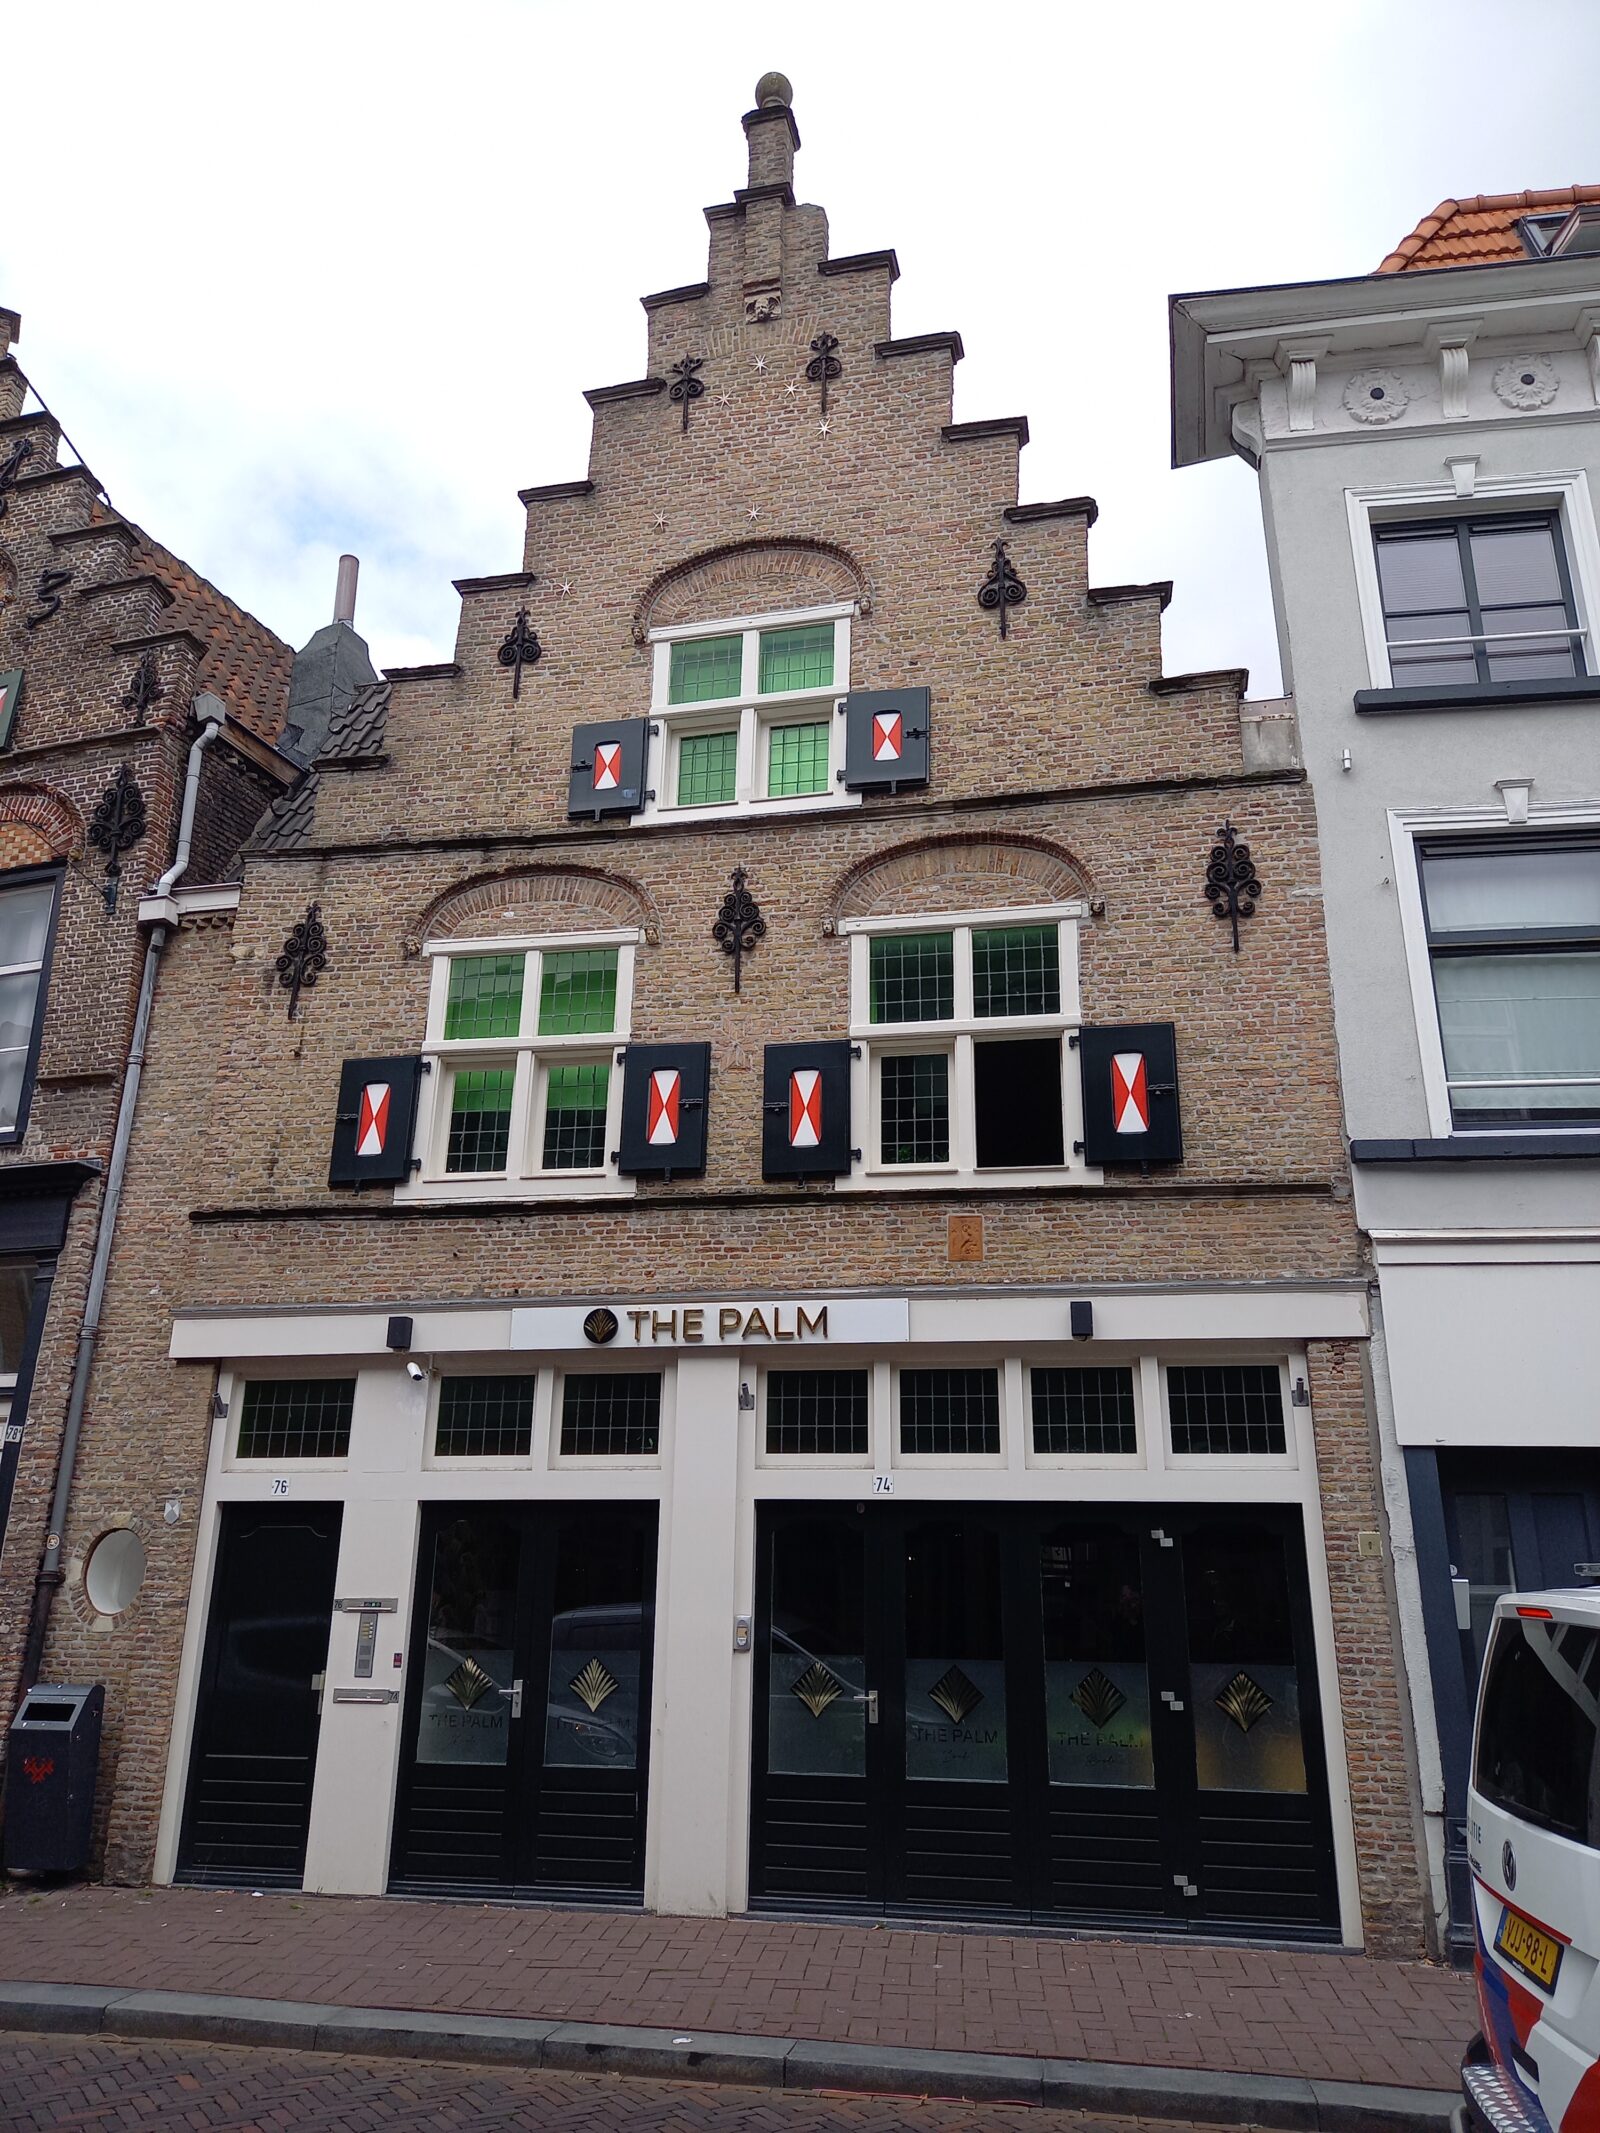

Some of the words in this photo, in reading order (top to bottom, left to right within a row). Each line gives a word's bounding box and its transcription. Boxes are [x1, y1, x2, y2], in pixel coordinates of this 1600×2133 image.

[626, 1308, 705, 1342] THE
[719, 1305, 829, 1341] PALM
[6, 1427, 19, 1440] 78
[274, 1479, 287, 1494] 76
[876, 1477, 890, 1492] 74
[428, 1714, 457, 1728] THE
[462, 1714, 503, 1728] PALM
[915, 1728, 947, 1742] THE
[952, 1728, 998, 1744] PALM
[1056, 1732, 1090, 1746] THE
